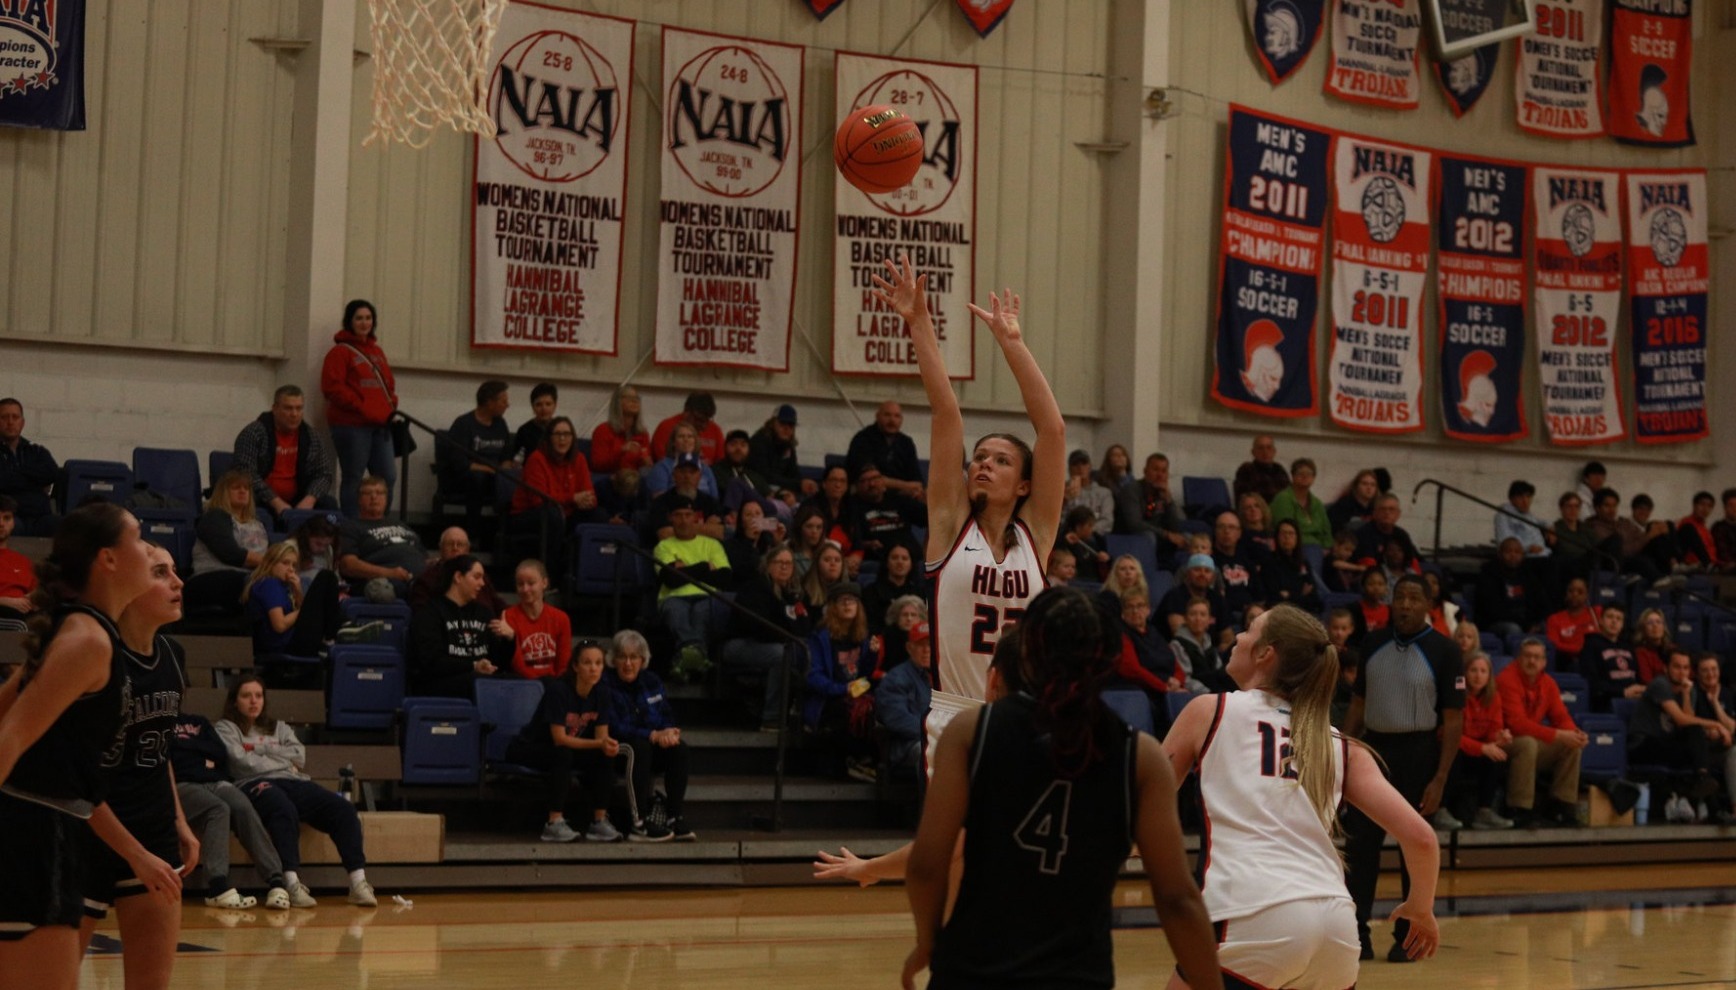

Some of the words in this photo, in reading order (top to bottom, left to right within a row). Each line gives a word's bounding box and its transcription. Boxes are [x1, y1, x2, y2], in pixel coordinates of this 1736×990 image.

[1535, 4, 1584, 42] 2011
[543, 51, 573, 72] 25-8
[1630, 34, 1677, 60] SOCCER
[721, 64, 748, 84] 24-8
[497, 62, 616, 154] NAIA
[891, 90, 925, 105] 28-7
[671, 77, 784, 162] NAIA
[1256, 122, 1307, 154] MEN'S
[1353, 146, 1415, 190] NAIA
[477, 182, 541, 212] WOMENS
[543, 190, 622, 222] NATIONAL
[1249, 174, 1308, 220] 2011
[1549, 177, 1607, 214] NAIA
[1640, 184, 1693, 218] NAIA
[496, 209, 598, 245] BASKETBALL
[660, 200, 722, 227] WOMENS
[724, 205, 796, 233] NATIONAL
[837, 214, 897, 239] WOMENS
[901, 220, 969, 244] NATIONAL
[1455, 216, 1514, 249] 2012
[496, 234, 599, 270] TOURNAMENT
[674, 226, 773, 256] BASKETBALL
[851, 241, 953, 269] BASKETBALL
[507, 263, 583, 295] HANNIBAL
[672, 250, 773, 280] TOURNAMENT
[505, 287, 585, 319] LAGRANGE
[683, 277, 760, 305] HANNIBAL
[1237, 286, 1299, 320] SOCCER
[679, 302, 761, 330] LAGRANGE
[1352, 290, 1409, 330] 2011
[504, 314, 580, 344] COLLEGE
[683, 327, 757, 354] COLLEGE
[1374, 333, 1411, 351] SOCCE
[1449, 322, 1507, 348] SOCCER
[1552, 314, 1608, 347] 2012
[1646, 315, 1700, 346] 2016
[1576, 352, 1611, 367] SOCCE
[1336, 393, 1409, 422] TROJANS
[971, 564, 1030, 599] HLGU
[1013, 780, 1072, 875] 4
